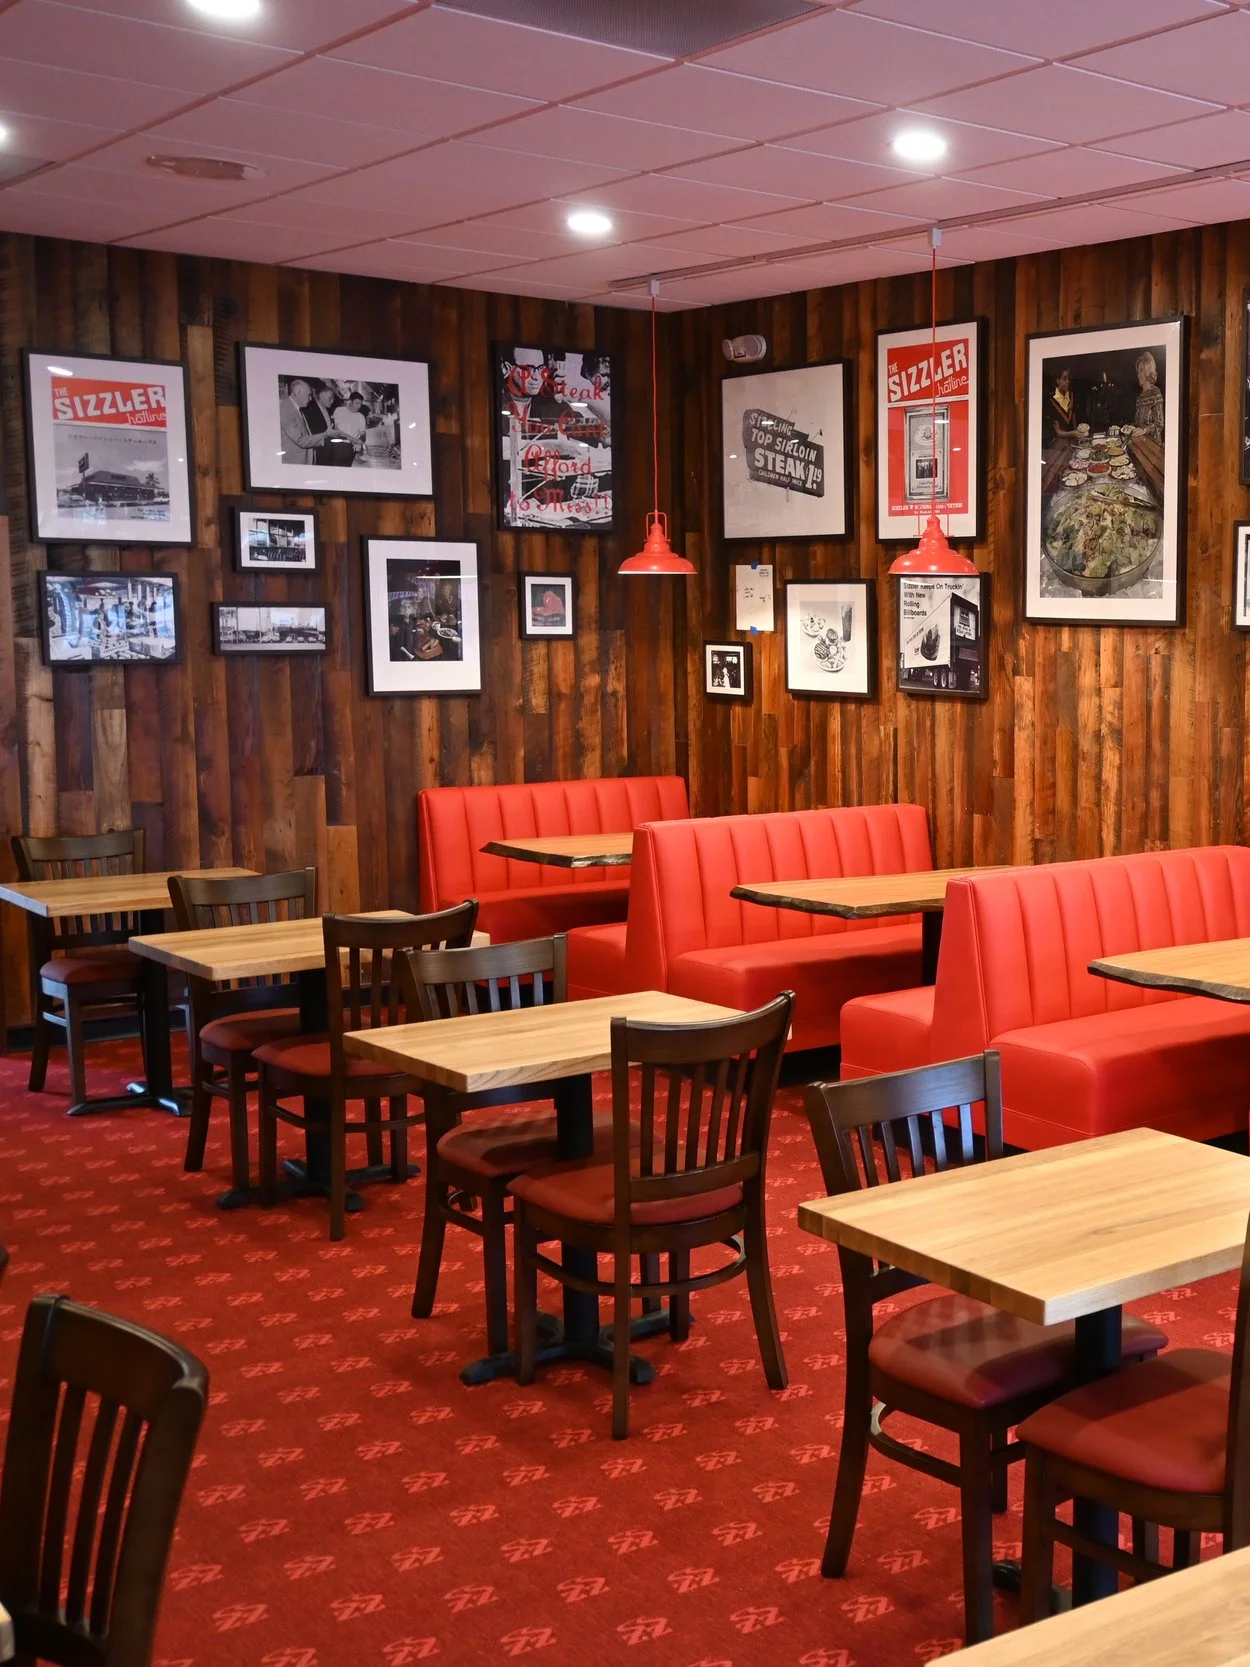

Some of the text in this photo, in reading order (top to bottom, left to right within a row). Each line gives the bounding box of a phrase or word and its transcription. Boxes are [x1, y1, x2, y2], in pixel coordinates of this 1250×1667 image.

[541, 367, 605, 401] Steak
[888, 343, 967, 402] SIZZLER
[889, 362, 898, 375] THE
[54, 387, 68, 398] THE
[54, 386, 166, 420] SIZZLER
[751, 428, 817, 462] TOP SIRLOIN
[524, 444, 592, 483] Afford
[754, 447, 806, 480] STEAK
[936, 582, 944, 590] On
[903, 600, 920, 609] Rolling
[903, 608, 927, 617] Billboards
